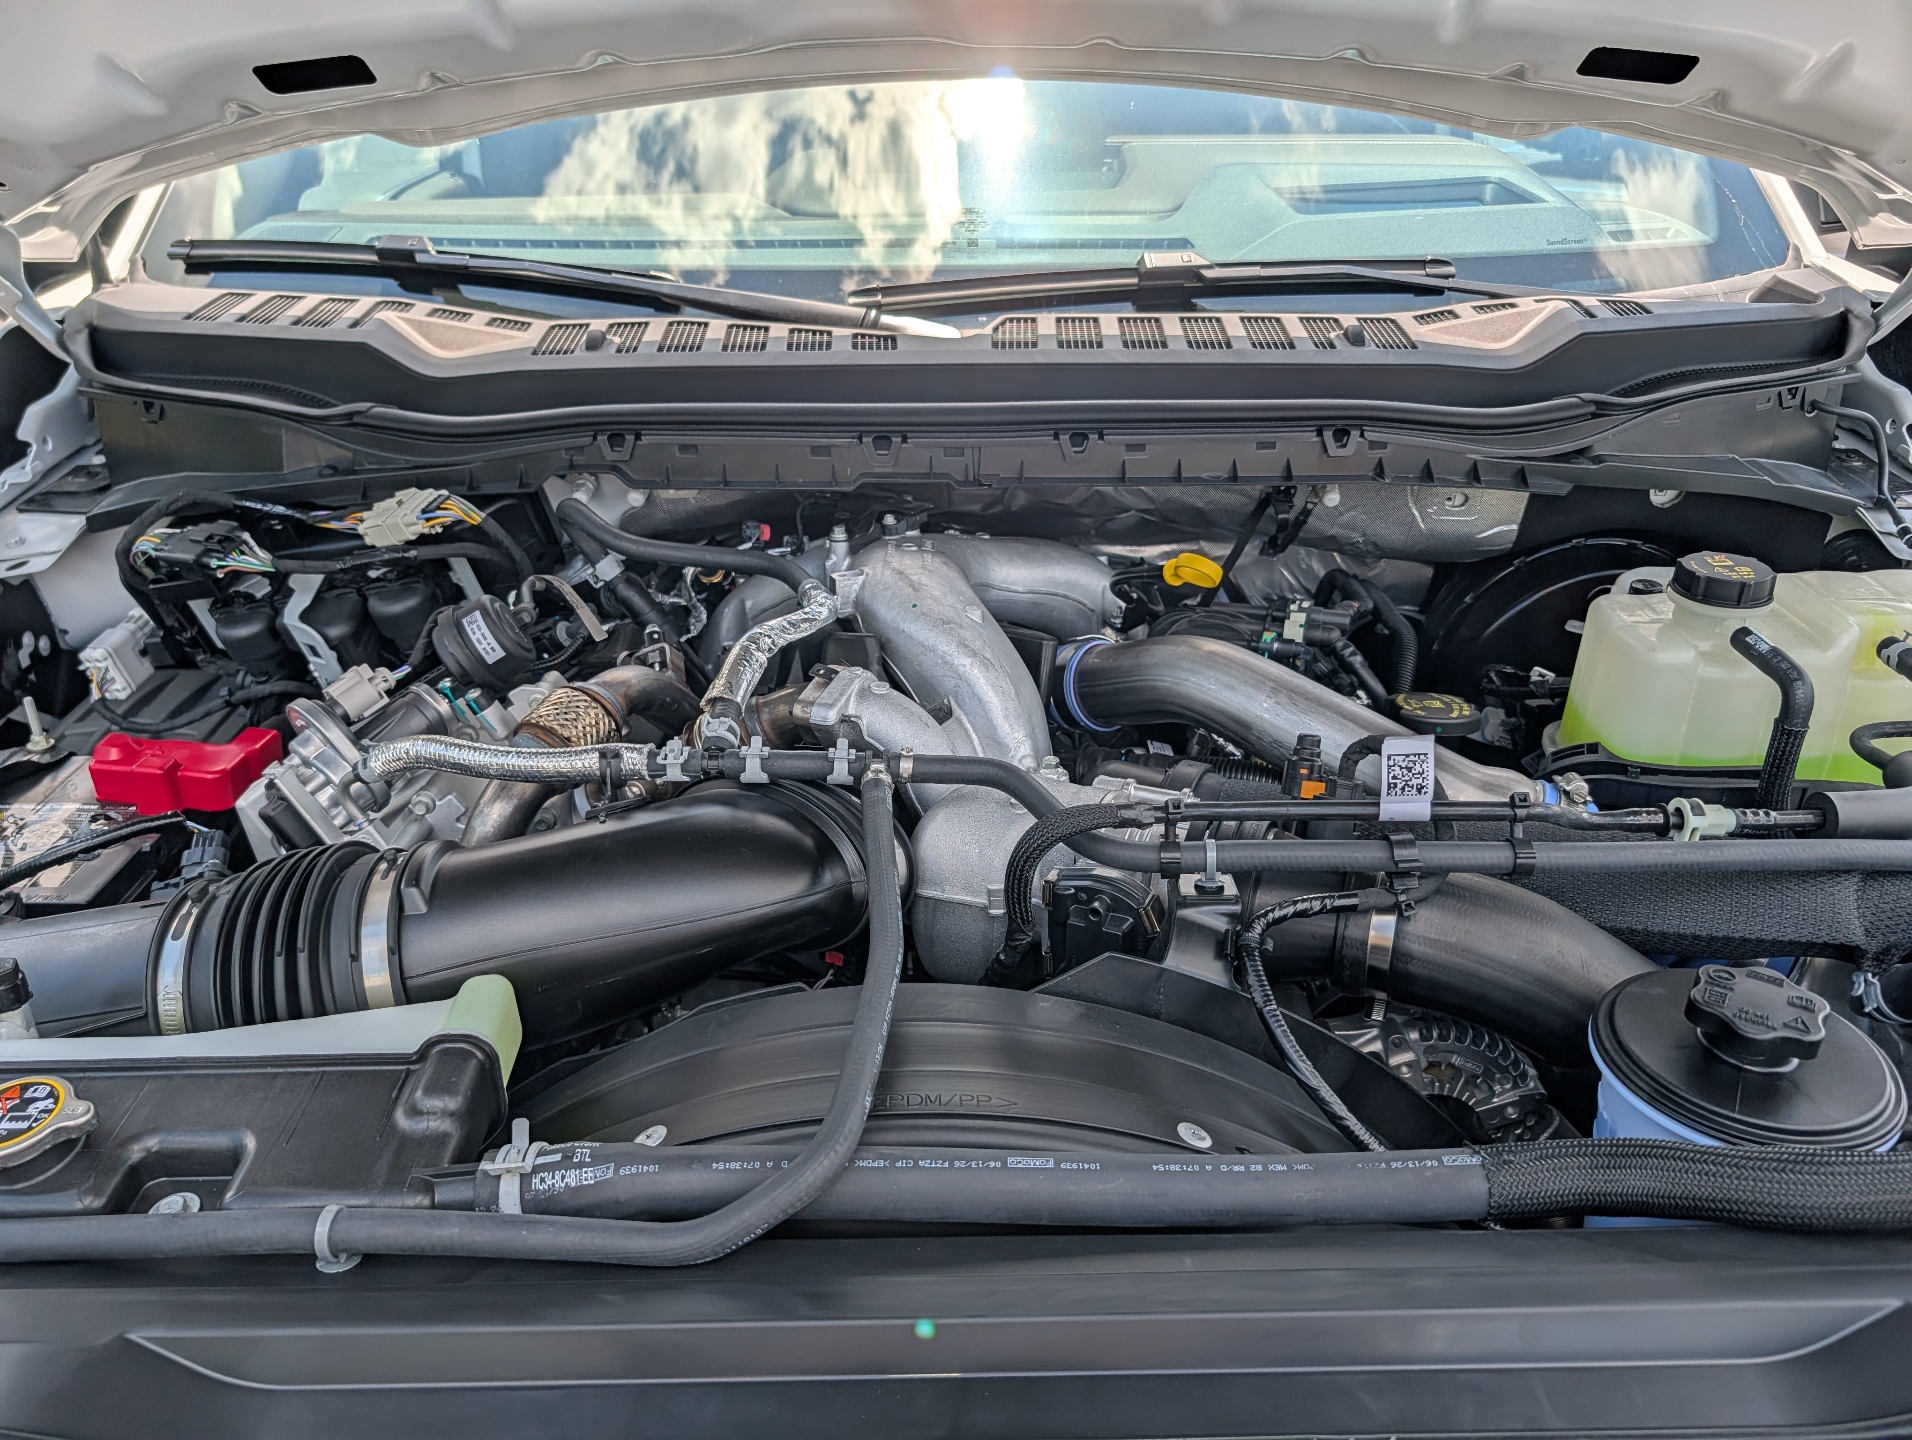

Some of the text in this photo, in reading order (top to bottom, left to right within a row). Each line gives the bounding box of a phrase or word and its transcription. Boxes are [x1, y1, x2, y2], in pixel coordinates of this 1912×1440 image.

[573, 1149, 592, 1162] BTL
[711, 1160, 761, 1170] 07:38:54
[766, 1160, 774, 1168] A
[894, 1159, 914, 1167] CIP
[953, 1160, 1001, 1168] 06/13/26
[1009, 1158, 1053, 1167] FoMoCo
[1390, 1159, 1438, 1168] 06/13/26
[1443, 1156, 1482, 1165] oMoCo
[619, 1163, 659, 1176] 1041939
[1060, 1162, 1101, 1170] 1041939
[532, 1166, 595, 1191] HC34-8C481-EE
